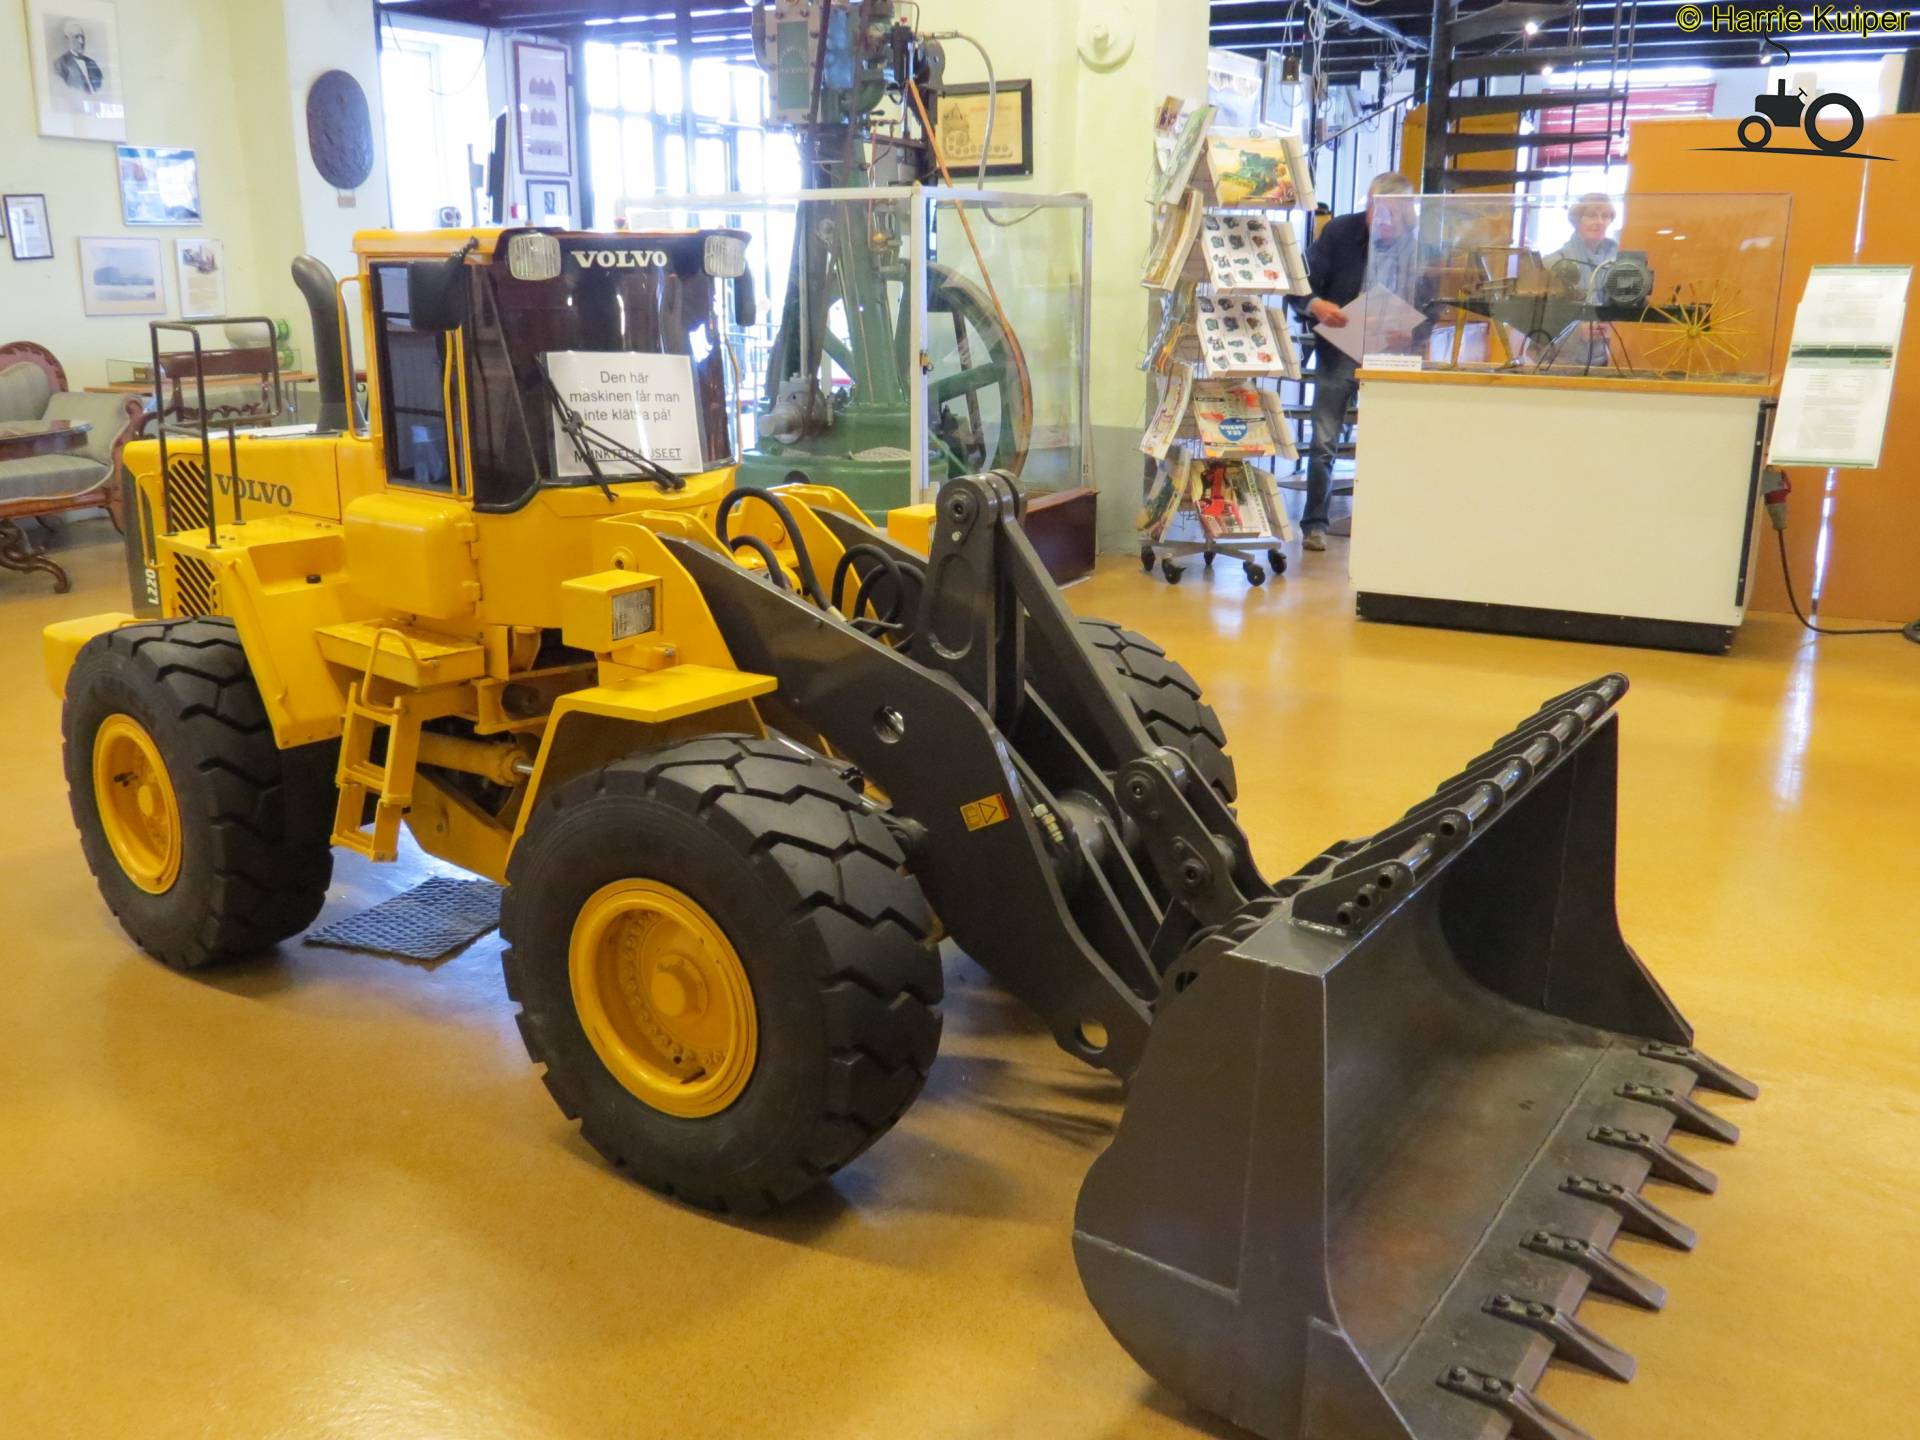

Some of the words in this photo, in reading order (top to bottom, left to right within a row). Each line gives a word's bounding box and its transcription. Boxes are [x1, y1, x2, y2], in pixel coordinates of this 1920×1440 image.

[571, 250, 668, 269] VOLVO
[600, 371, 626, 383] Den
[630, 372, 649, 383] här
[570, 391, 632, 402] maskinen
[655, 392, 680, 402] man
[584, 409, 607, 421] inte
[214, 473, 292, 507] VOLVO
